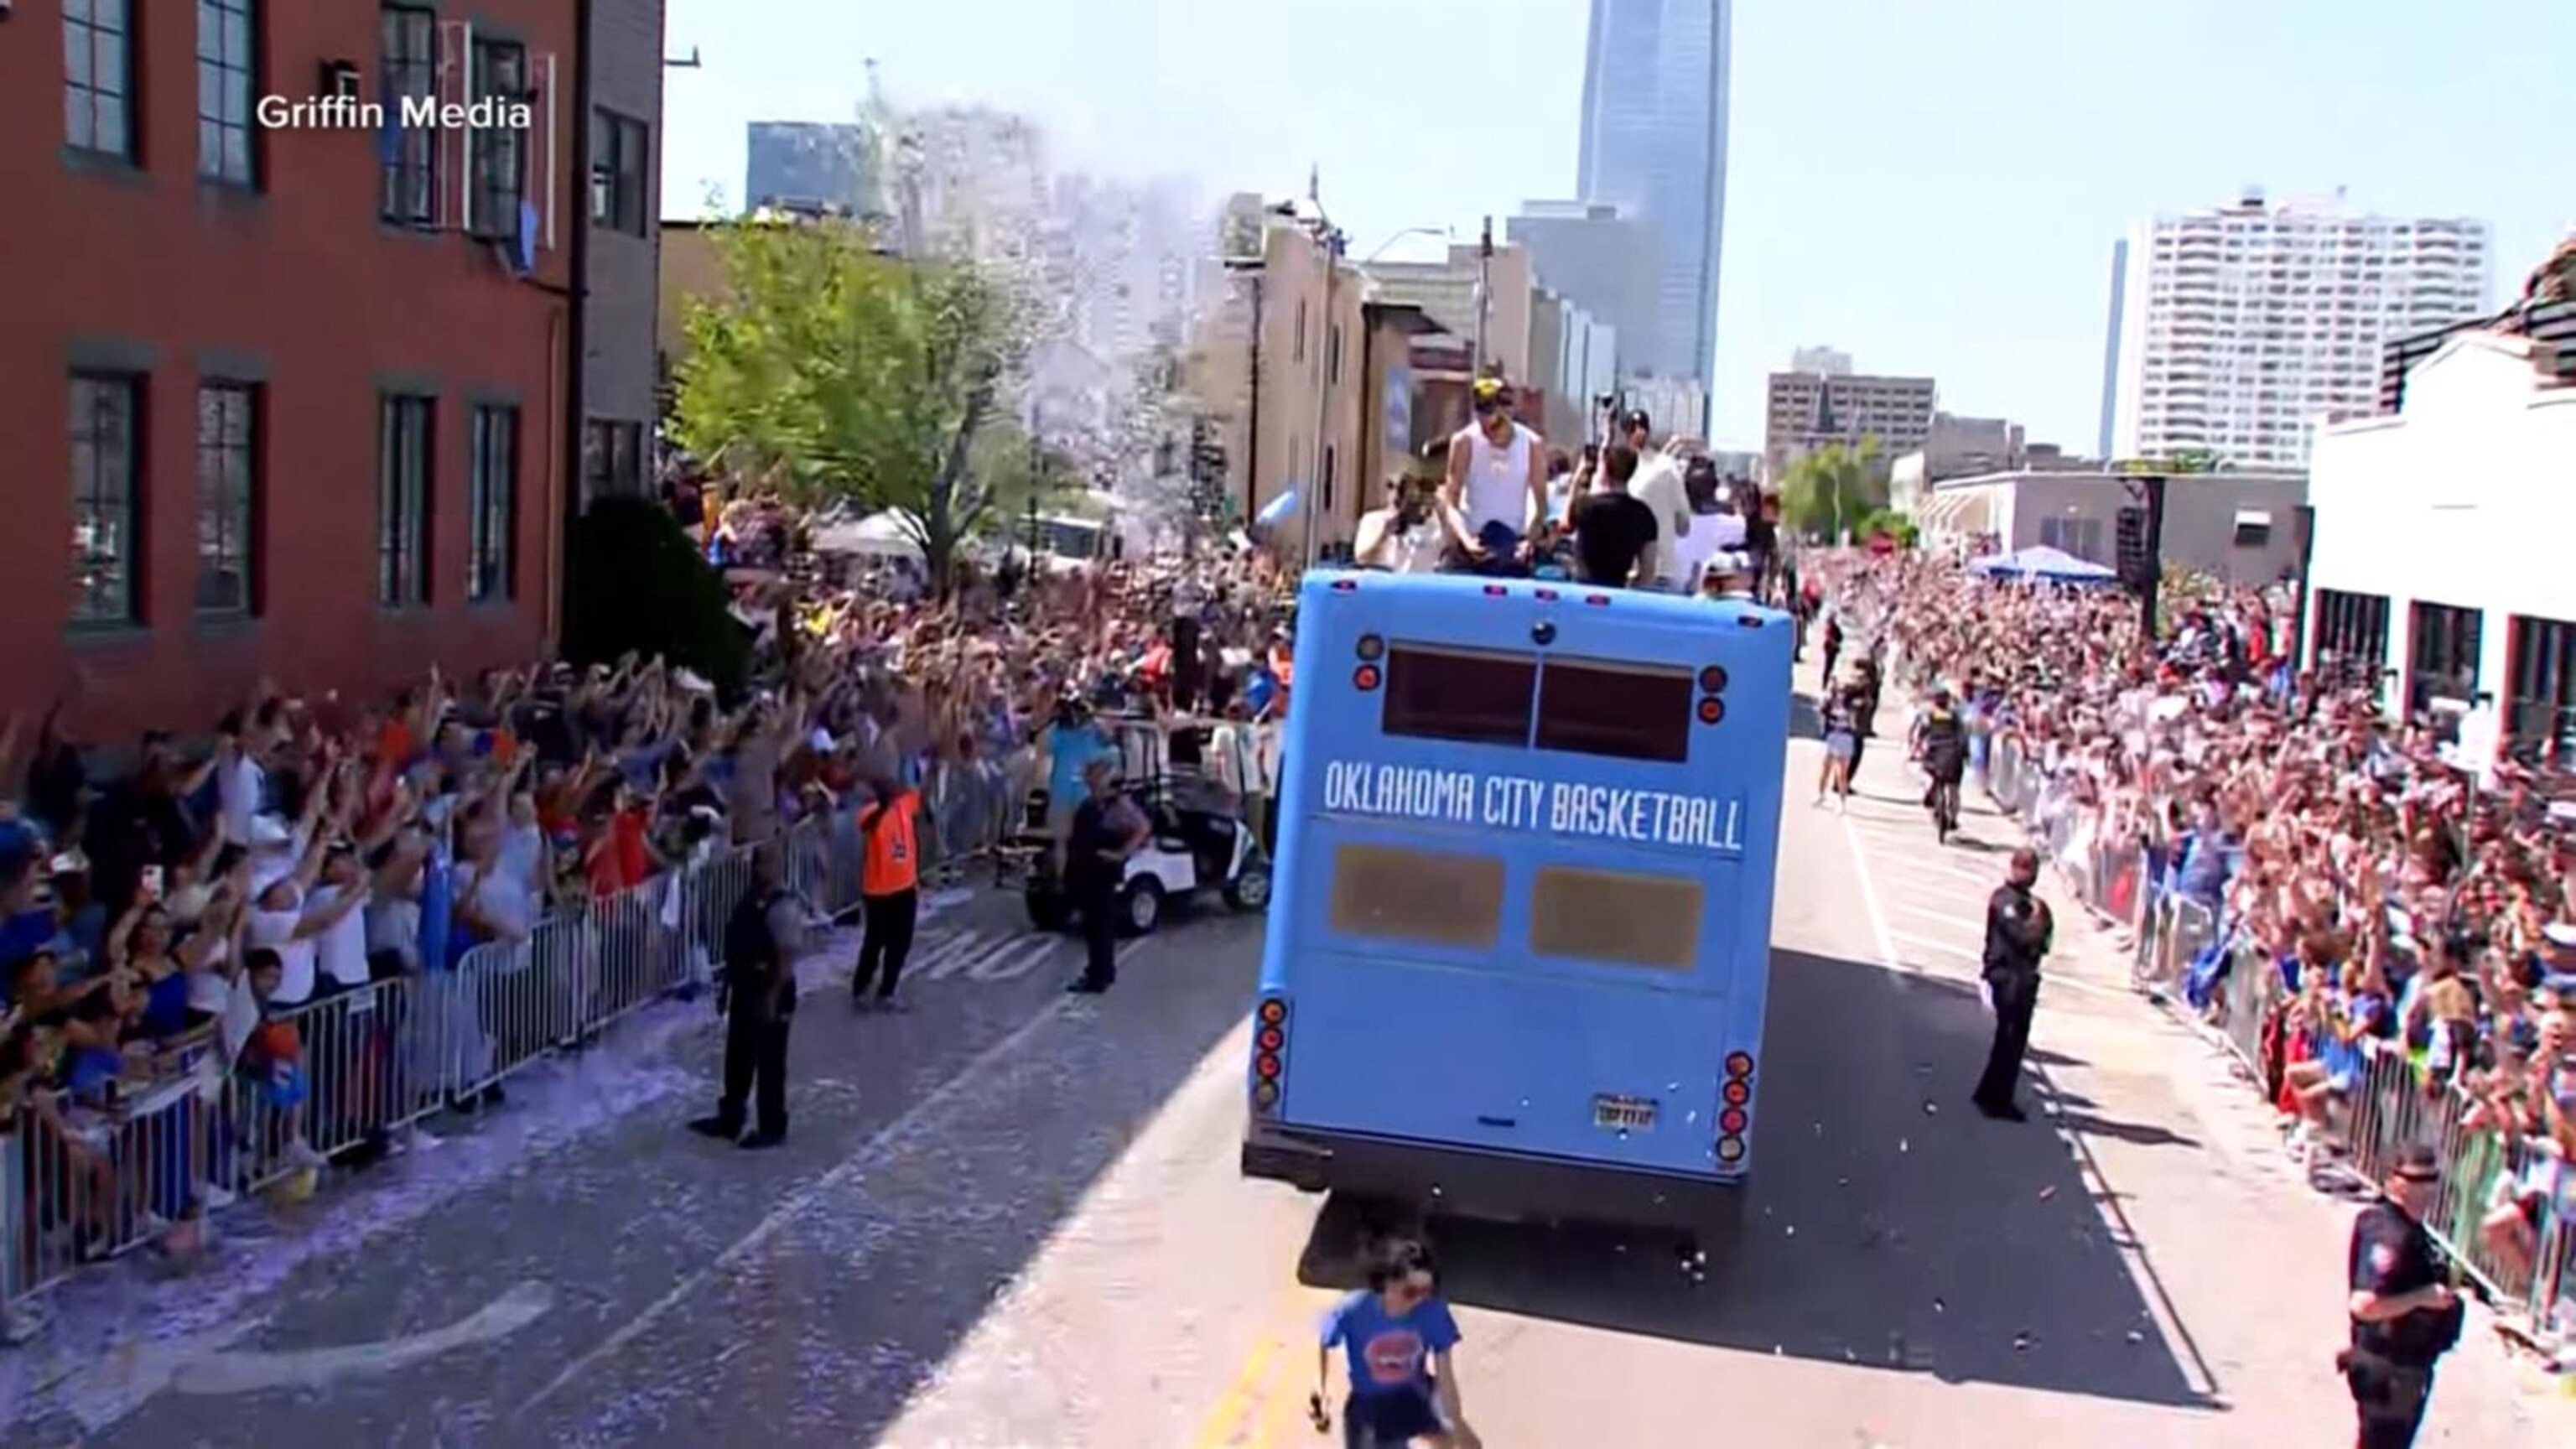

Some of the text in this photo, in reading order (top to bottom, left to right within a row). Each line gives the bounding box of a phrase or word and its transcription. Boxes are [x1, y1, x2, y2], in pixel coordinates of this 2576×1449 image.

[1325, 760, 1742, 851] OKLAHOMA CITY BASKETBALL
